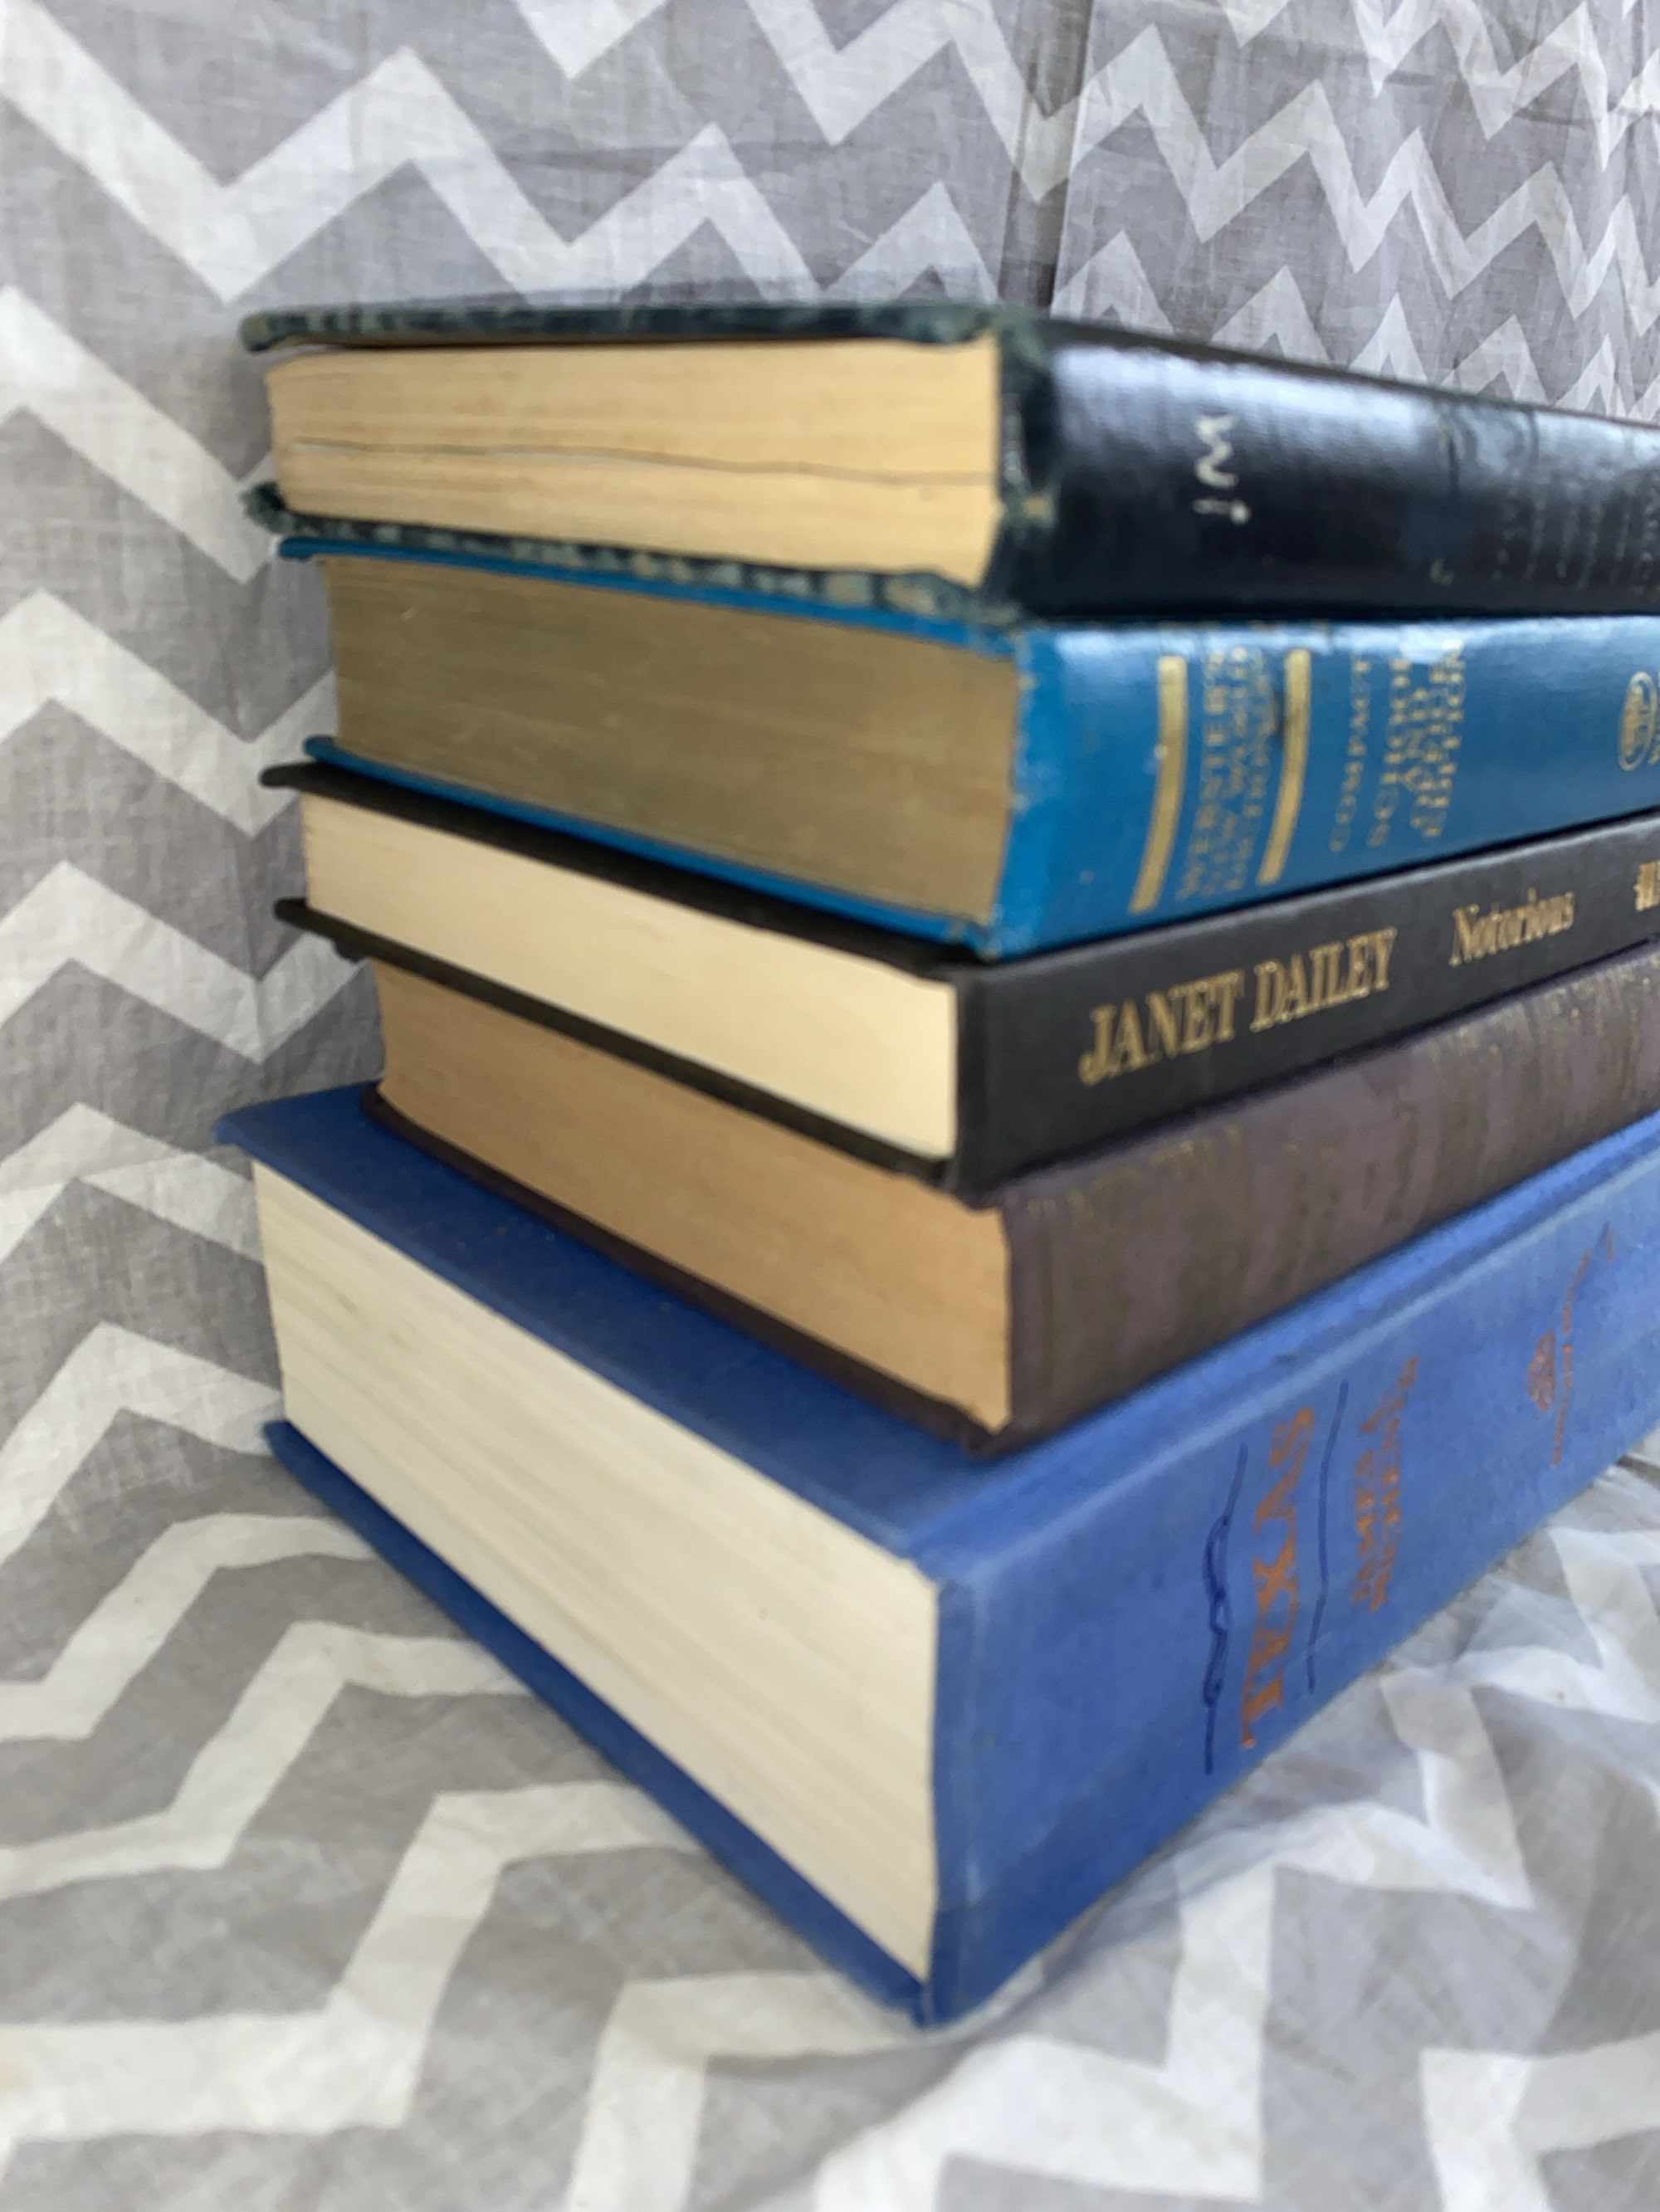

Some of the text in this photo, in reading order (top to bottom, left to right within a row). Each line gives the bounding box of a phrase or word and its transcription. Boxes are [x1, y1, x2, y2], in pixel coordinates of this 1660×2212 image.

[1080, 927, 1397, 1086] JANET DAILEY
[1449, 888, 1575, 966] Notorious
[1242, 1407, 1315, 1748] TEXAS
